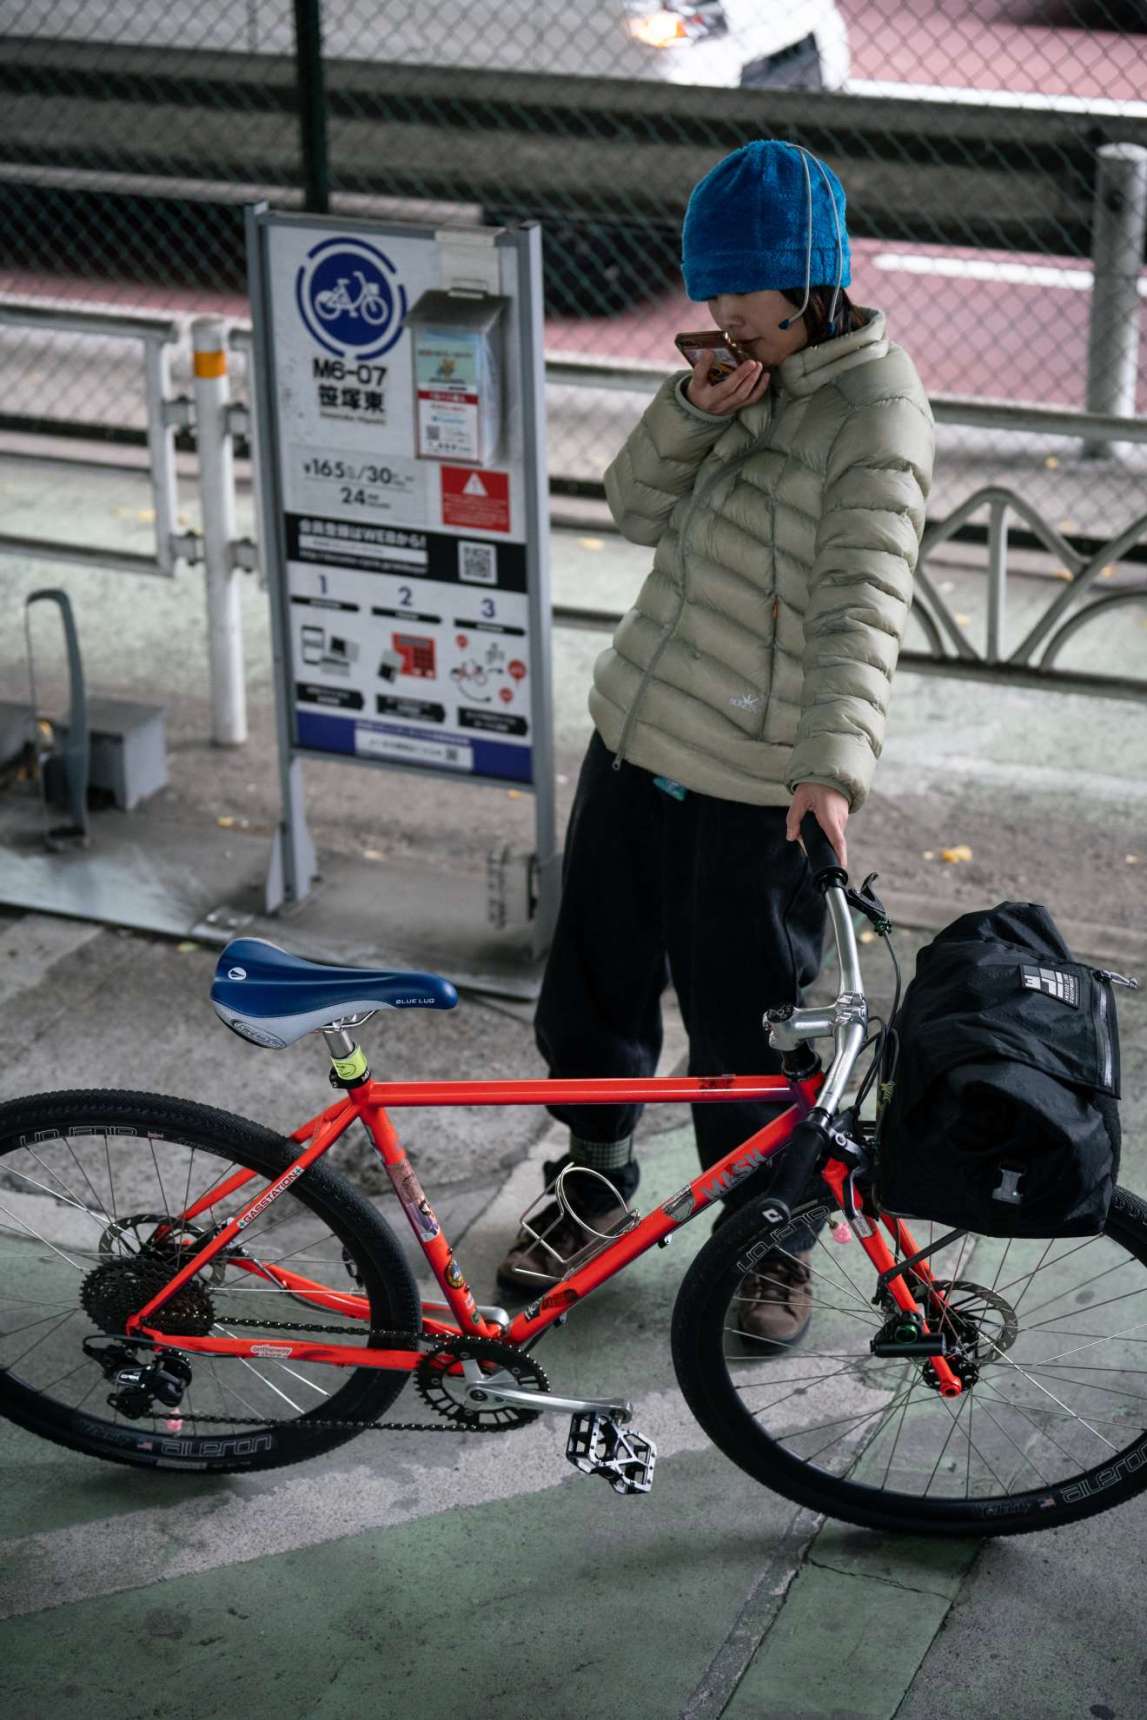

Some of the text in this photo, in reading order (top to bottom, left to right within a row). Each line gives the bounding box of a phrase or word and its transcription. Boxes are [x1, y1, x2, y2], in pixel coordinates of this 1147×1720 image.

[313, 357, 387, 386] M6-07
[340, 486, 365, 505] 24
[318, 574, 329, 595] 1
[398, 586, 413, 607] 2
[481, 598, 496, 619] 3
[701, 1148, 767, 1200] MASH
[161, 1434, 272, 1457] aileron
[1060, 1442, 1147, 1503] ailero
